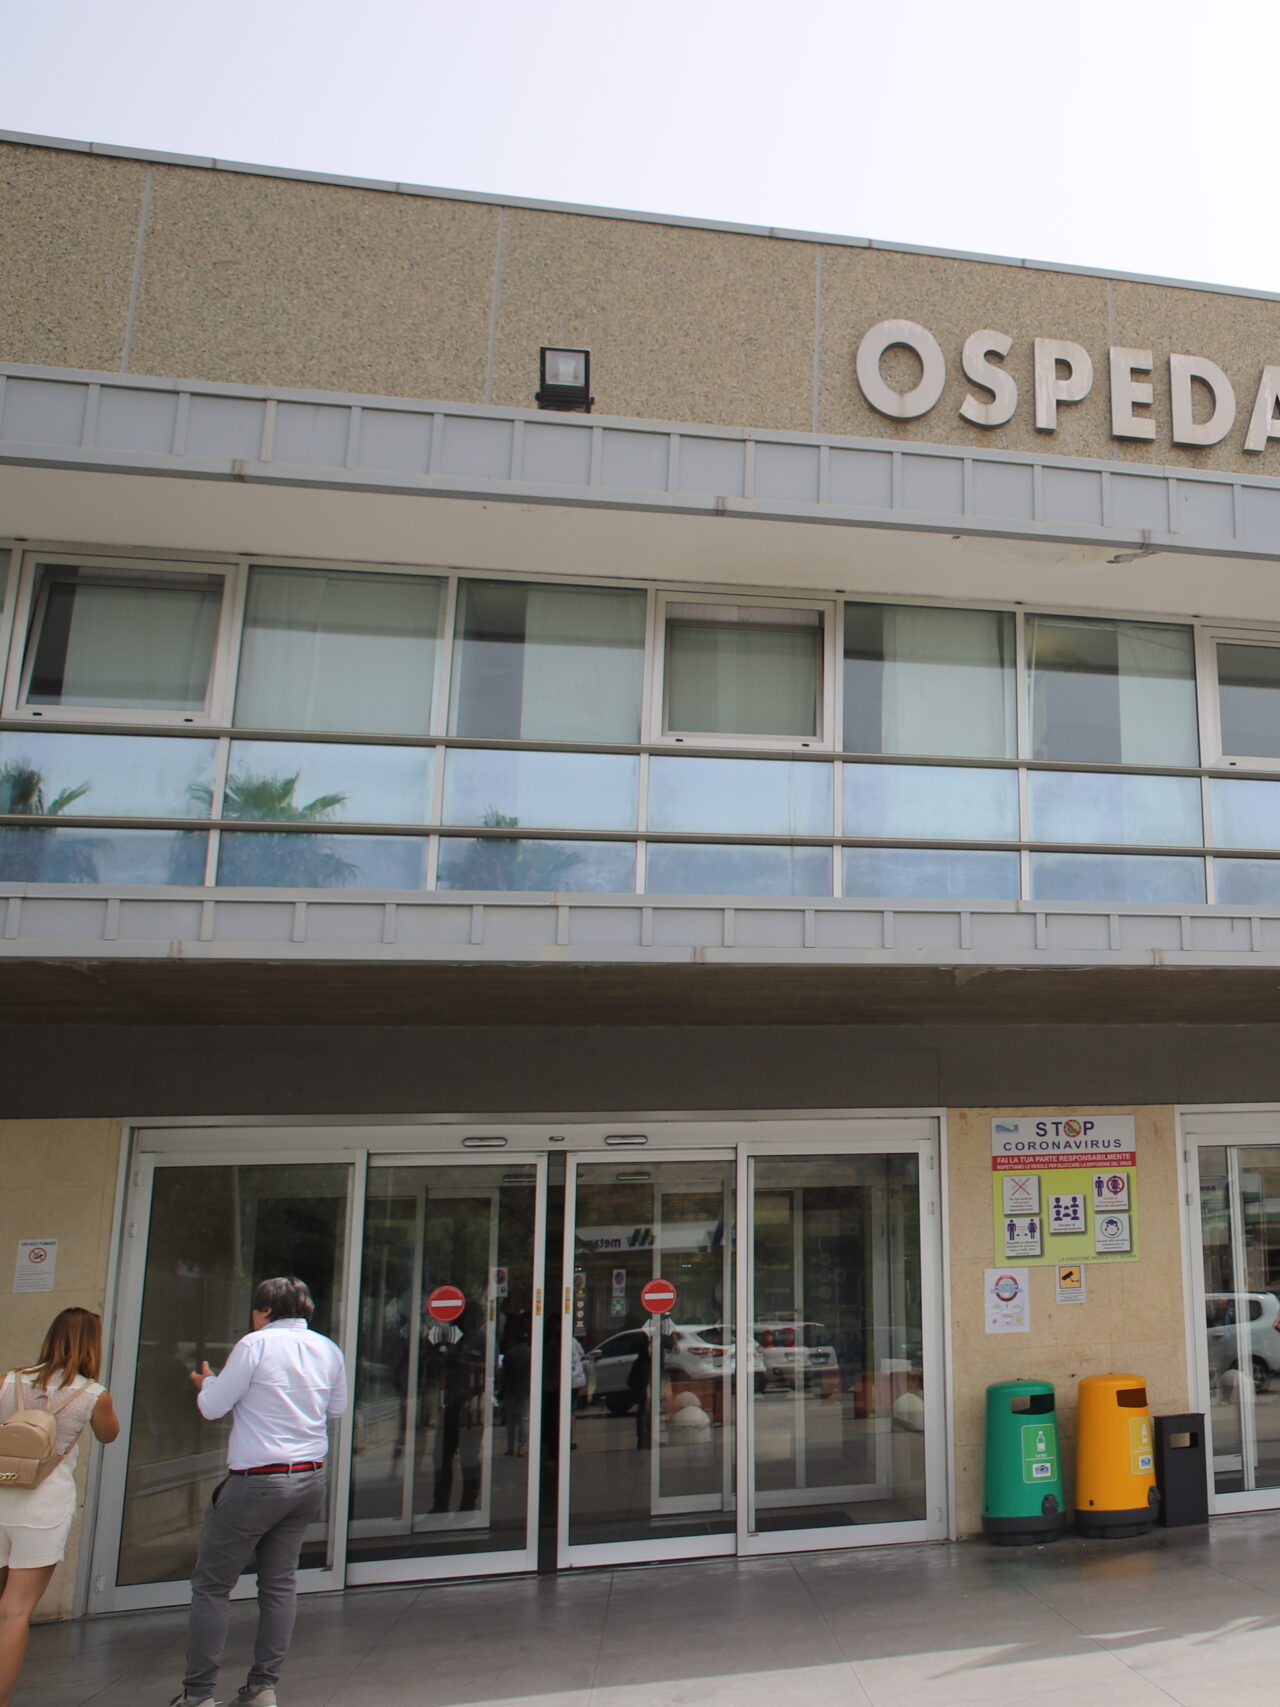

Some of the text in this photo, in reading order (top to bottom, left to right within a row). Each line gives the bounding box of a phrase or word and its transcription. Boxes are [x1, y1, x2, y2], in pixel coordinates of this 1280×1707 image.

[1003, 1139, 1122, 1151] CORONAVIRUS
[1035, 1155, 1057, 1163] PARTE
[1058, 1152, 1131, 1162] RESPONSABILMENTE
